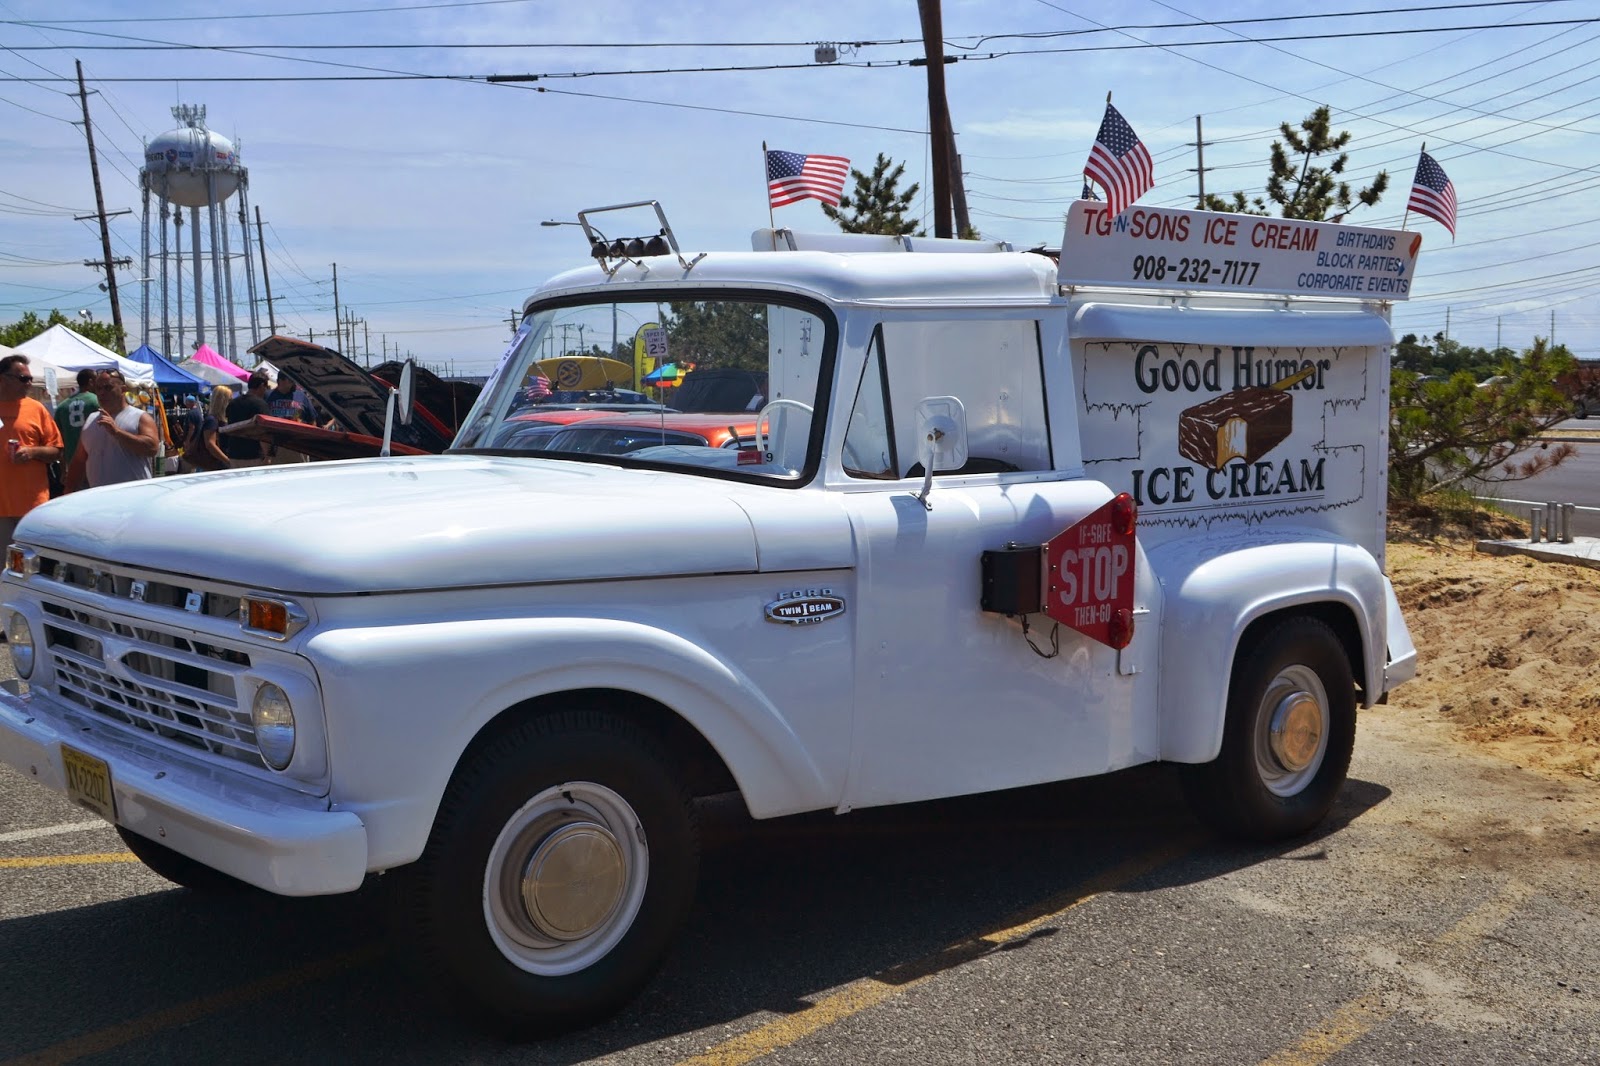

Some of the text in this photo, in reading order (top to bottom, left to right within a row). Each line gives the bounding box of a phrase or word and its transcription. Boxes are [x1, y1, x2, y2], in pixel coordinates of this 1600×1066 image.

[1130, 210, 1191, 242] SONS
[1203, 217, 1239, 246] ICE
[1251, 221, 1319, 252] CREAM
[1336, 231, 1396, 251] BIRTHDAYS
[1132, 254, 1261, 286] 908-232-7177
[1316, 251, 1401, 272] BLOCK PARTIES
[1297, 272, 1409, 293] CORPORATE EVENTS
[649, 342, 667, 354] 25
[1134, 344, 1331, 394] Good Humor
[68, 398, 86, 428] 8
[1131, 457, 1326, 506] ICE CREAM
[1079, 523, 1112, 545] IF-SAFE
[1059, 544, 1128, 606] STOP
[778, 588, 833, 600] FORD
[780, 606, 801, 616] TWIN
[809, 603, 833, 613] BEAM
[1075, 603, 1111, 626] THEN-GO
